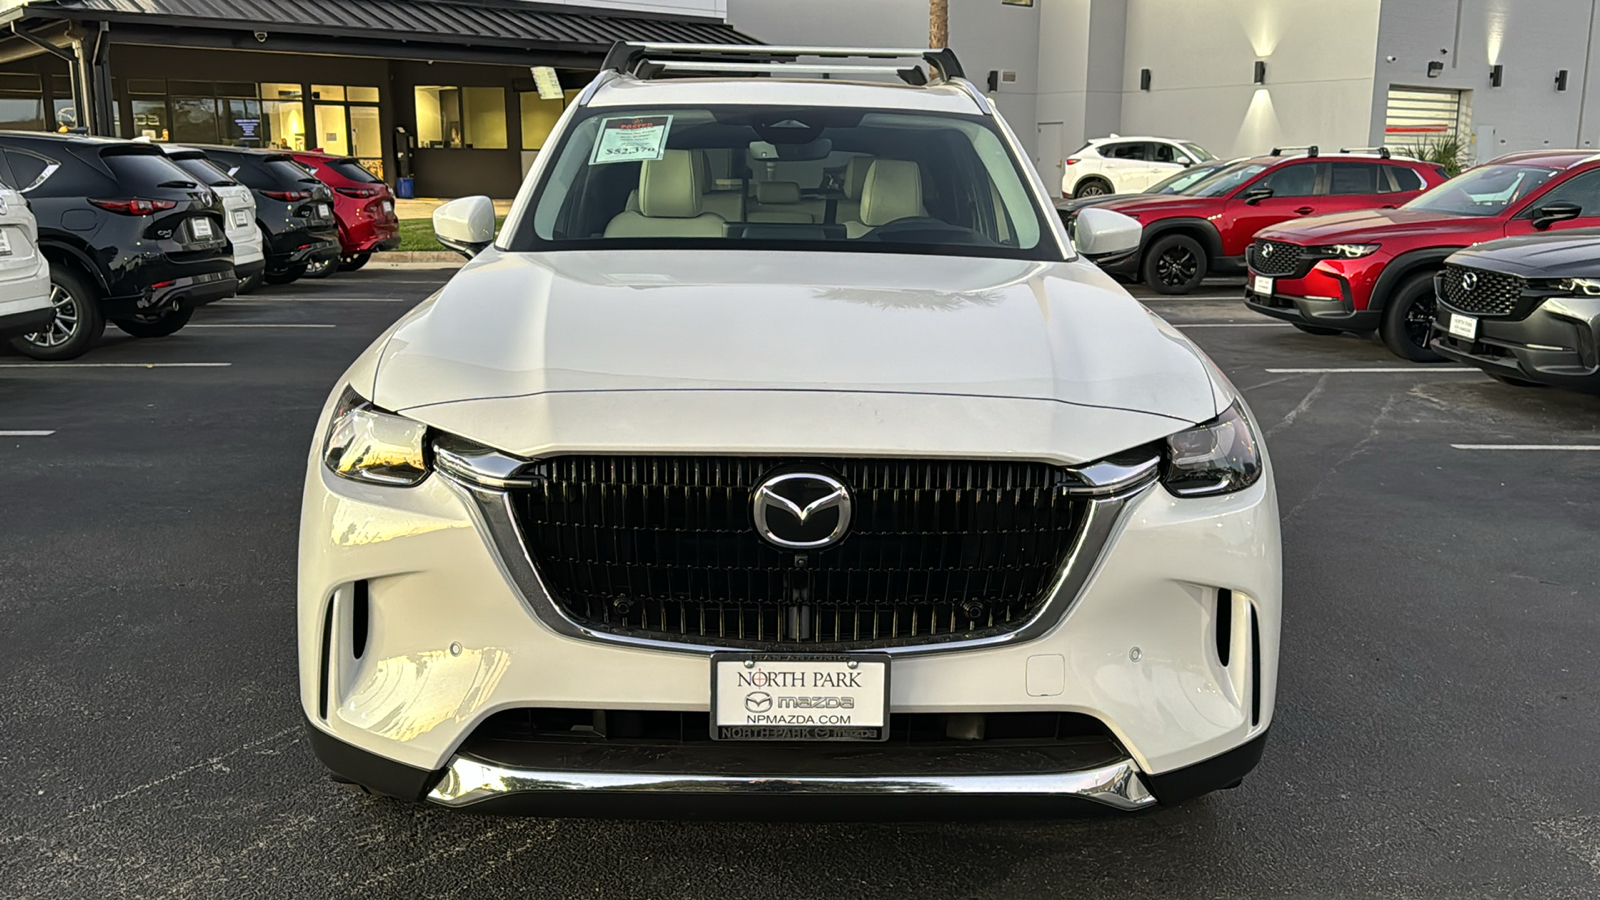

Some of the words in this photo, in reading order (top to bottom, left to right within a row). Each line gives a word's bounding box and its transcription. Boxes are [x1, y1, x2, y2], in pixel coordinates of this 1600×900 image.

[738, 671, 805, 688] NORTH
[813, 672, 862, 688] PARK
[778, 697, 855, 708] mazda
[747, 715, 851, 724] NPMAZDA.COM
[722, 727, 769, 739] NORTH
[774, 727, 811, 739] PARK
[834, 729, 878, 738] mazda
